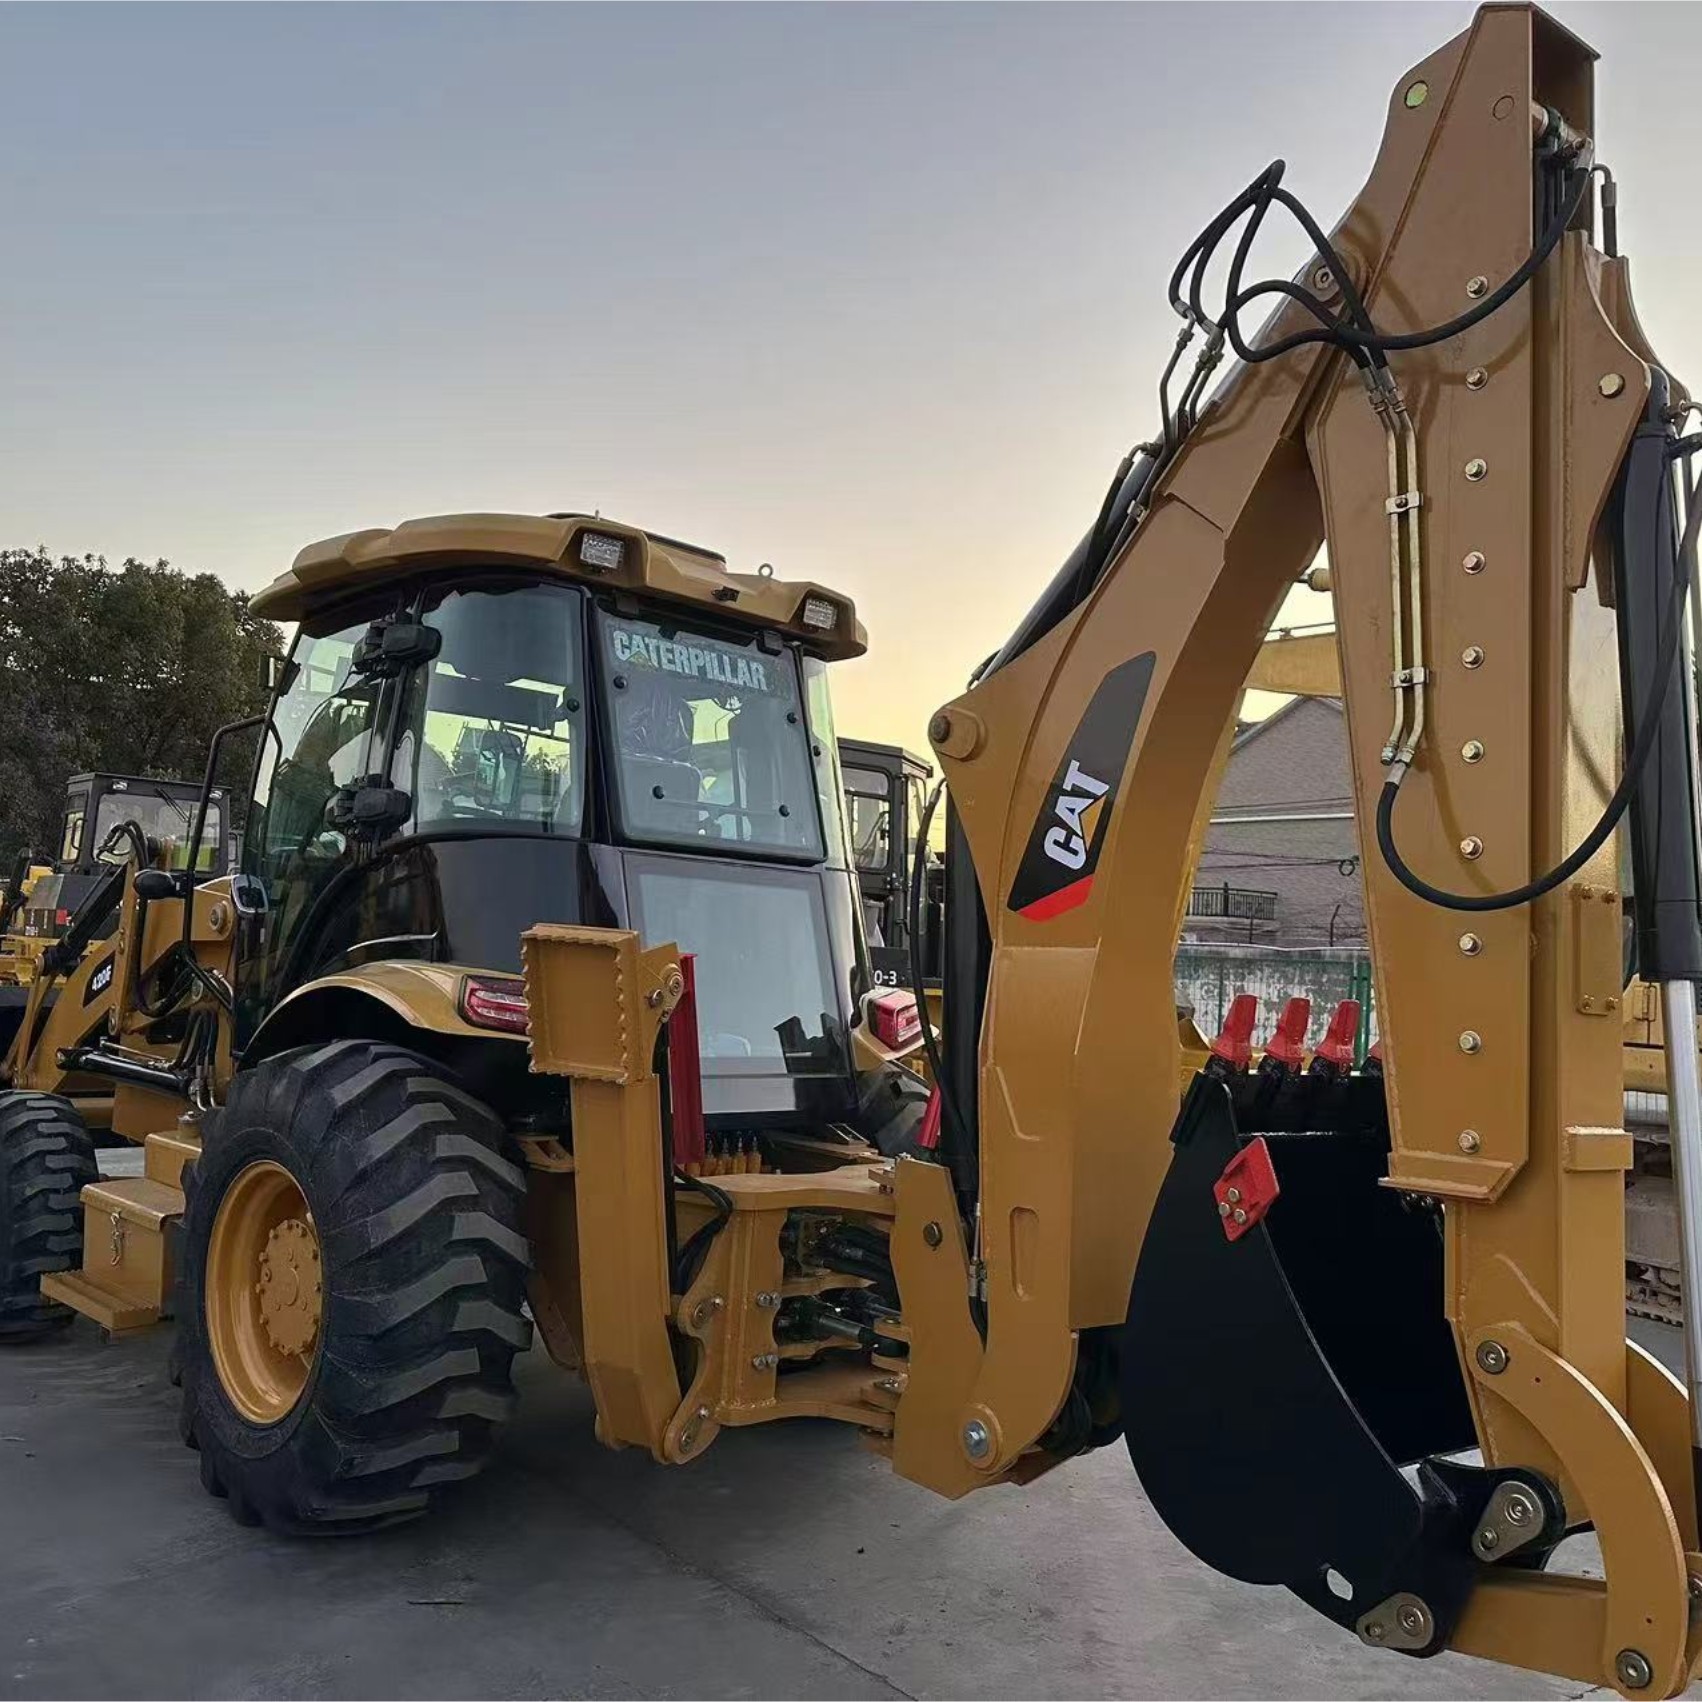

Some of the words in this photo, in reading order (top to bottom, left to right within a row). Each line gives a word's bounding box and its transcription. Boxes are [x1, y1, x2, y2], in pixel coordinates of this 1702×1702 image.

[613, 630, 767, 691] CATERPILLAR
[1044, 759, 1110, 870] CAT
[871, 969, 897, 985] 0-3
